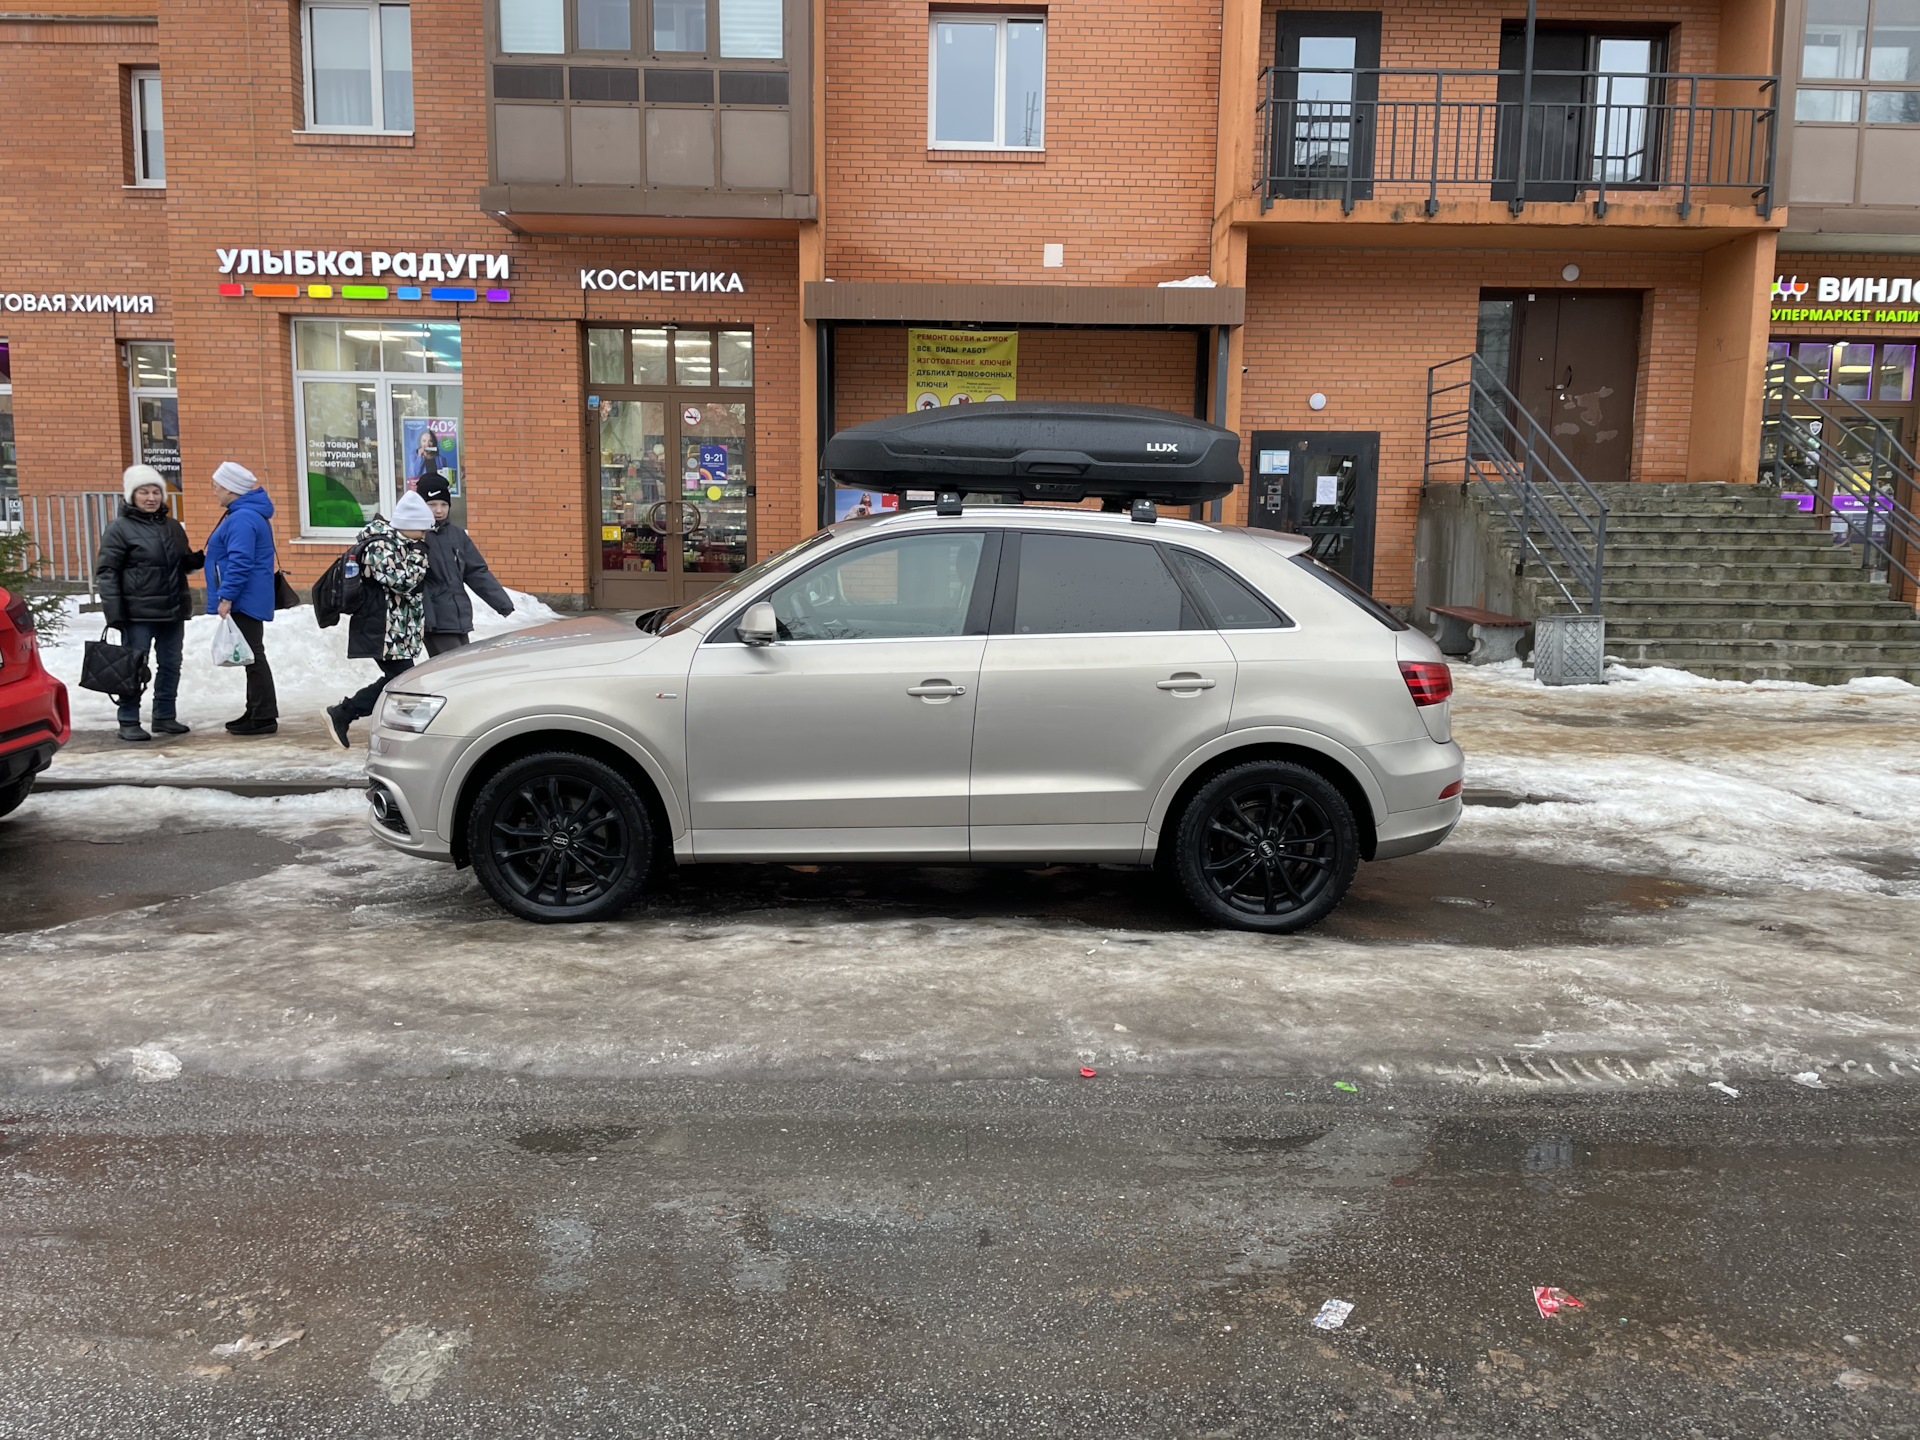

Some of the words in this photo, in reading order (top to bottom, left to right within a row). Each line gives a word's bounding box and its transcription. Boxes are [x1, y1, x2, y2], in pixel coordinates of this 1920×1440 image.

[580, 269, 745, 293] КОСМЕТИКА
[71, 294, 154, 313] ХИМИЯ
[1771, 308, 1871, 322] УПЕРМАРКЕТ
[1875, 310, 1920, 323] НАПИ
[916, 333, 948, 341] РЕМОНТ
[916, 357, 975, 366] ИЗГОТОВЛЕНИЕ
[916, 369, 955, 377] ДУБЛИКАТ
[309, 440, 325, 448] Эко
[327, 441, 358, 450] товары
[1146, 443, 1178, 452] LUX
[316, 451, 372, 460] натуральная
[704, 453, 723, 462] 9-21
[153, 464, 180, 472] лфетки
